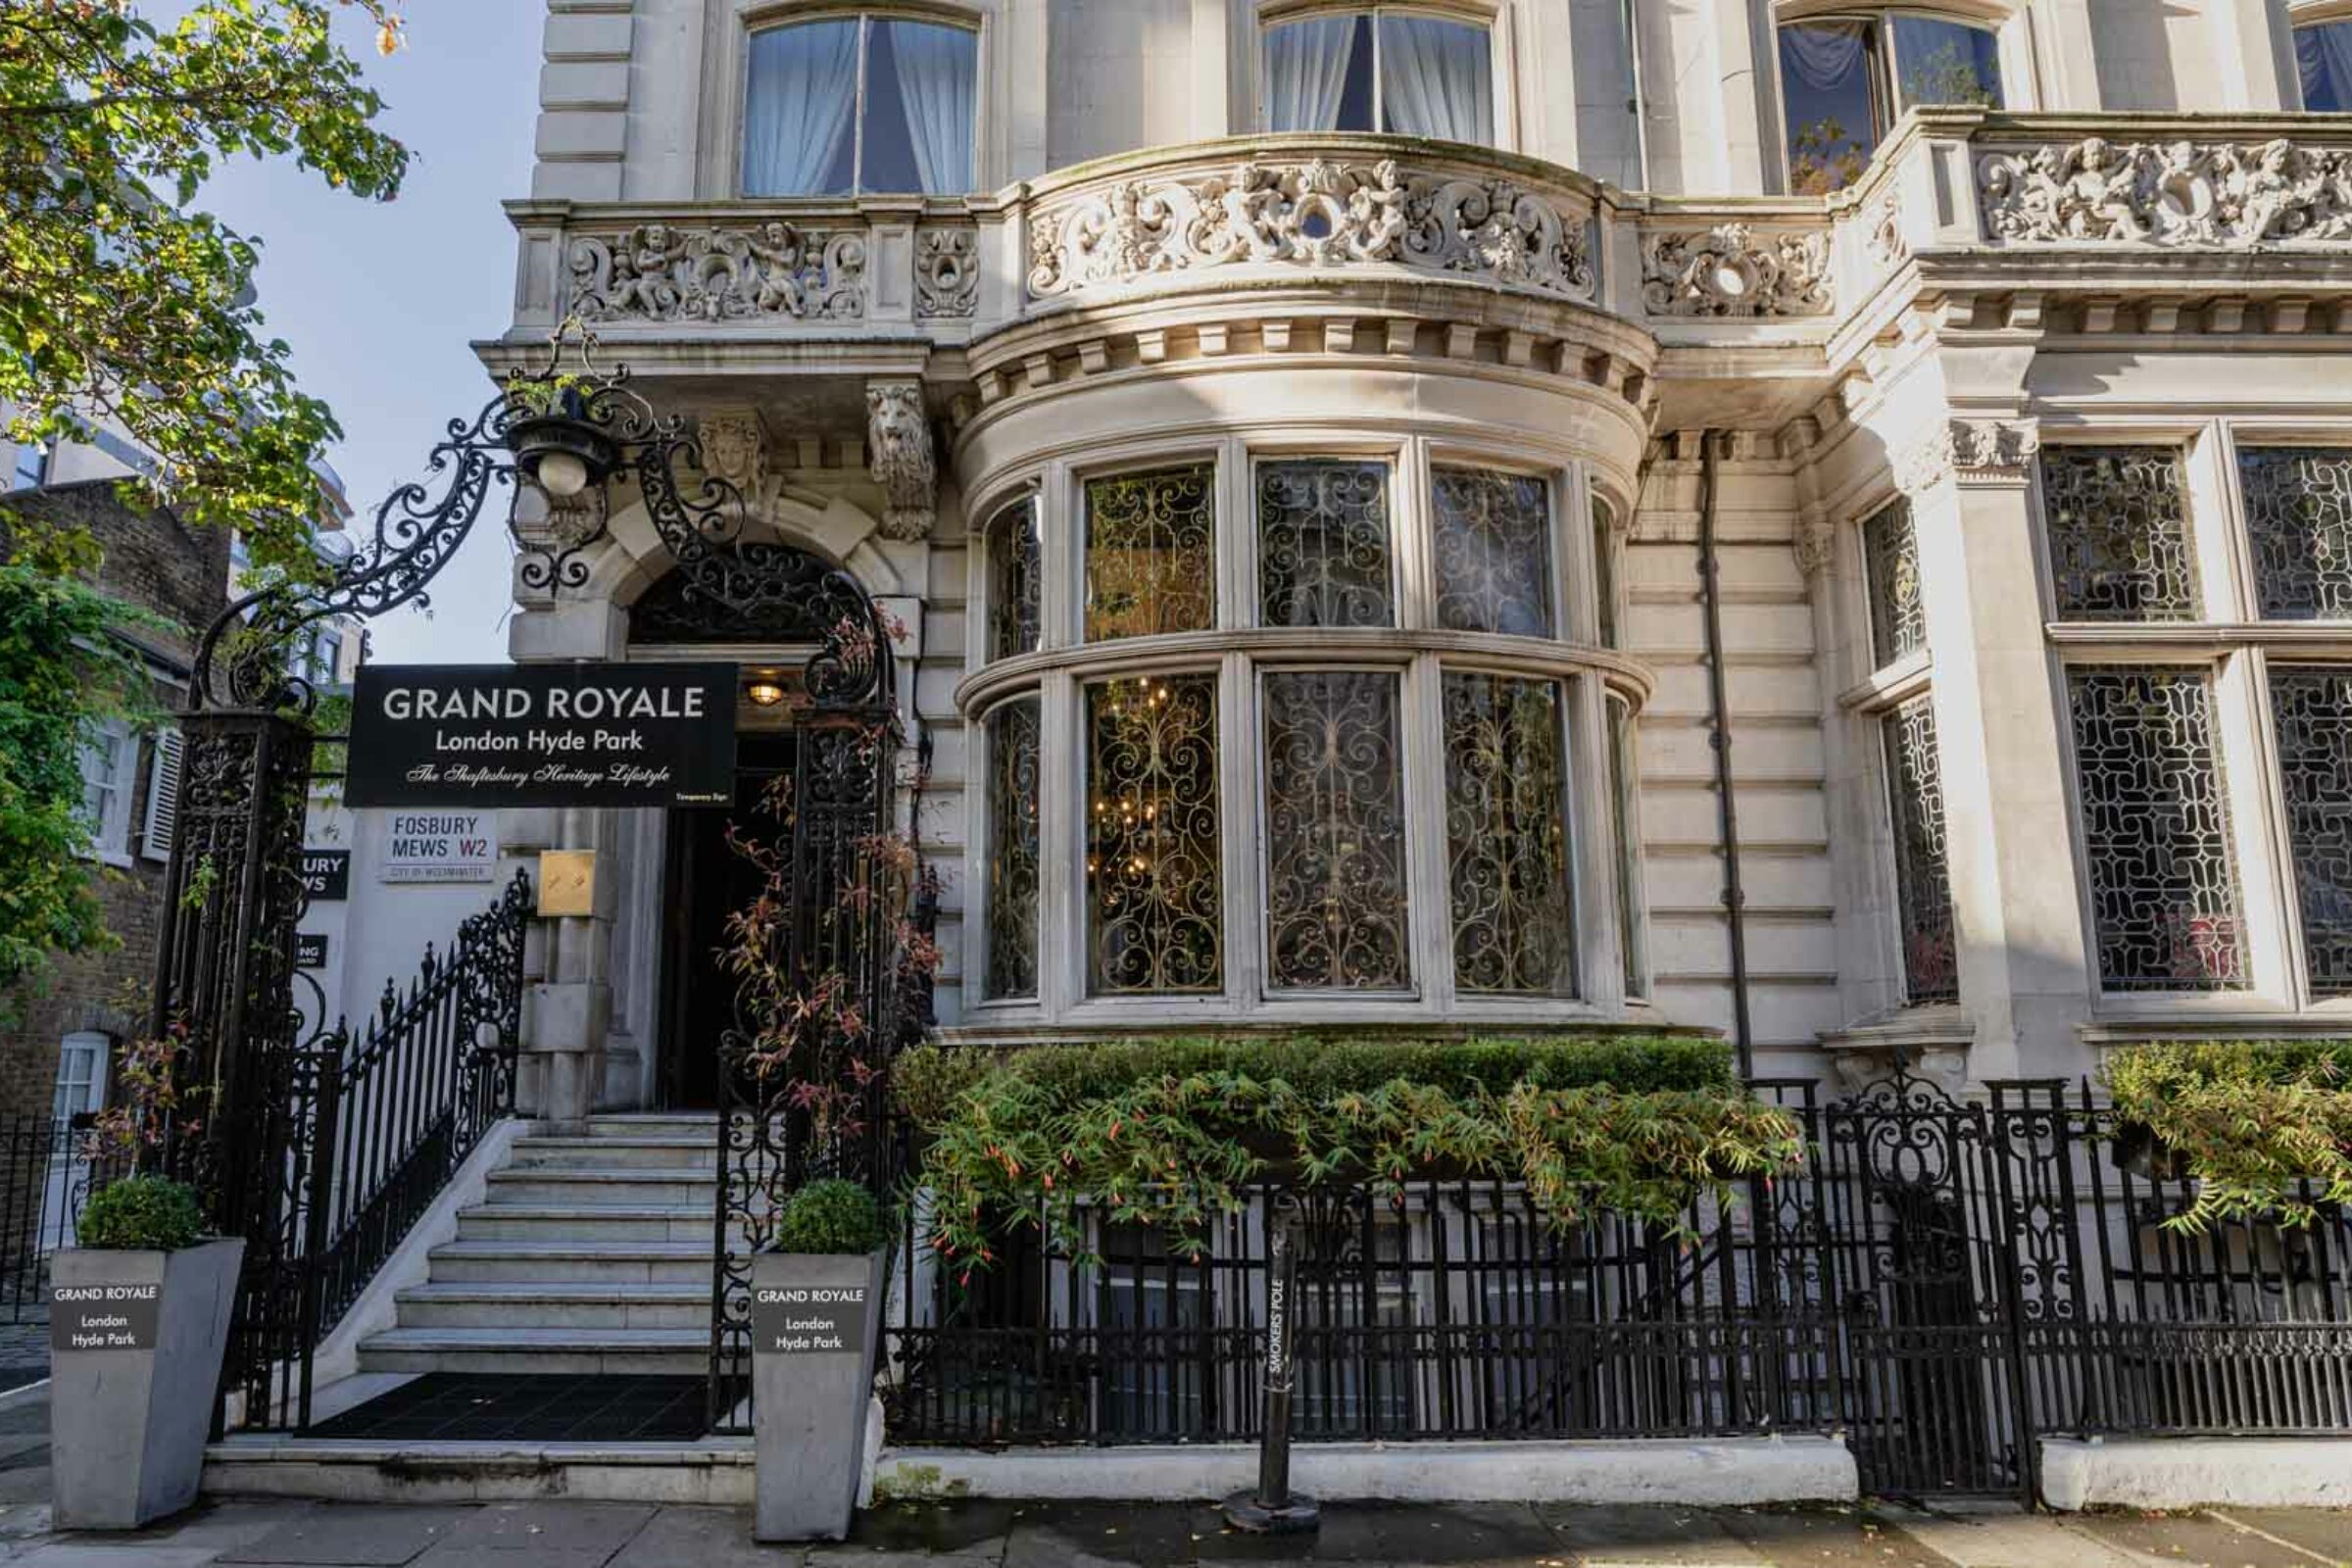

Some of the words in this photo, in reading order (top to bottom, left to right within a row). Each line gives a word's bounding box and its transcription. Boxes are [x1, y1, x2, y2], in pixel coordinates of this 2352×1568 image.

[383, 688, 532, 719] GRAND
[547, 687, 705, 718] ROYALE
[436, 730, 519, 751] London
[528, 730, 586, 755] Hyde
[594, 729, 643, 751] Park
[406, 764, 440, 782] The
[443, 763, 529, 788] Shaftesbury
[532, 763, 605, 788] Heritage
[608, 762, 670, 788] Lifestyle
[394, 816, 478, 835] FOSBURY
[393, 839, 448, 858] MEWS
[460, 839, 487, 858] W2
[302, 858, 344, 872] URY
[54, 1288, 103, 1301] GRAND
[106, 1287, 157, 1299] ROYALE
[758, 1290, 808, 1301] GRAND
[811, 1290, 863, 1301] ROYALE
[1271, 1278, 1284, 1309] POLE
[81, 1314, 127, 1327] London
[786, 1317, 834, 1330] London
[73, 1333, 104, 1348] Hyde
[108, 1332, 135, 1346] Park
[776, 1336, 809, 1350] Hyde
[813, 1336, 843, 1348] Park
